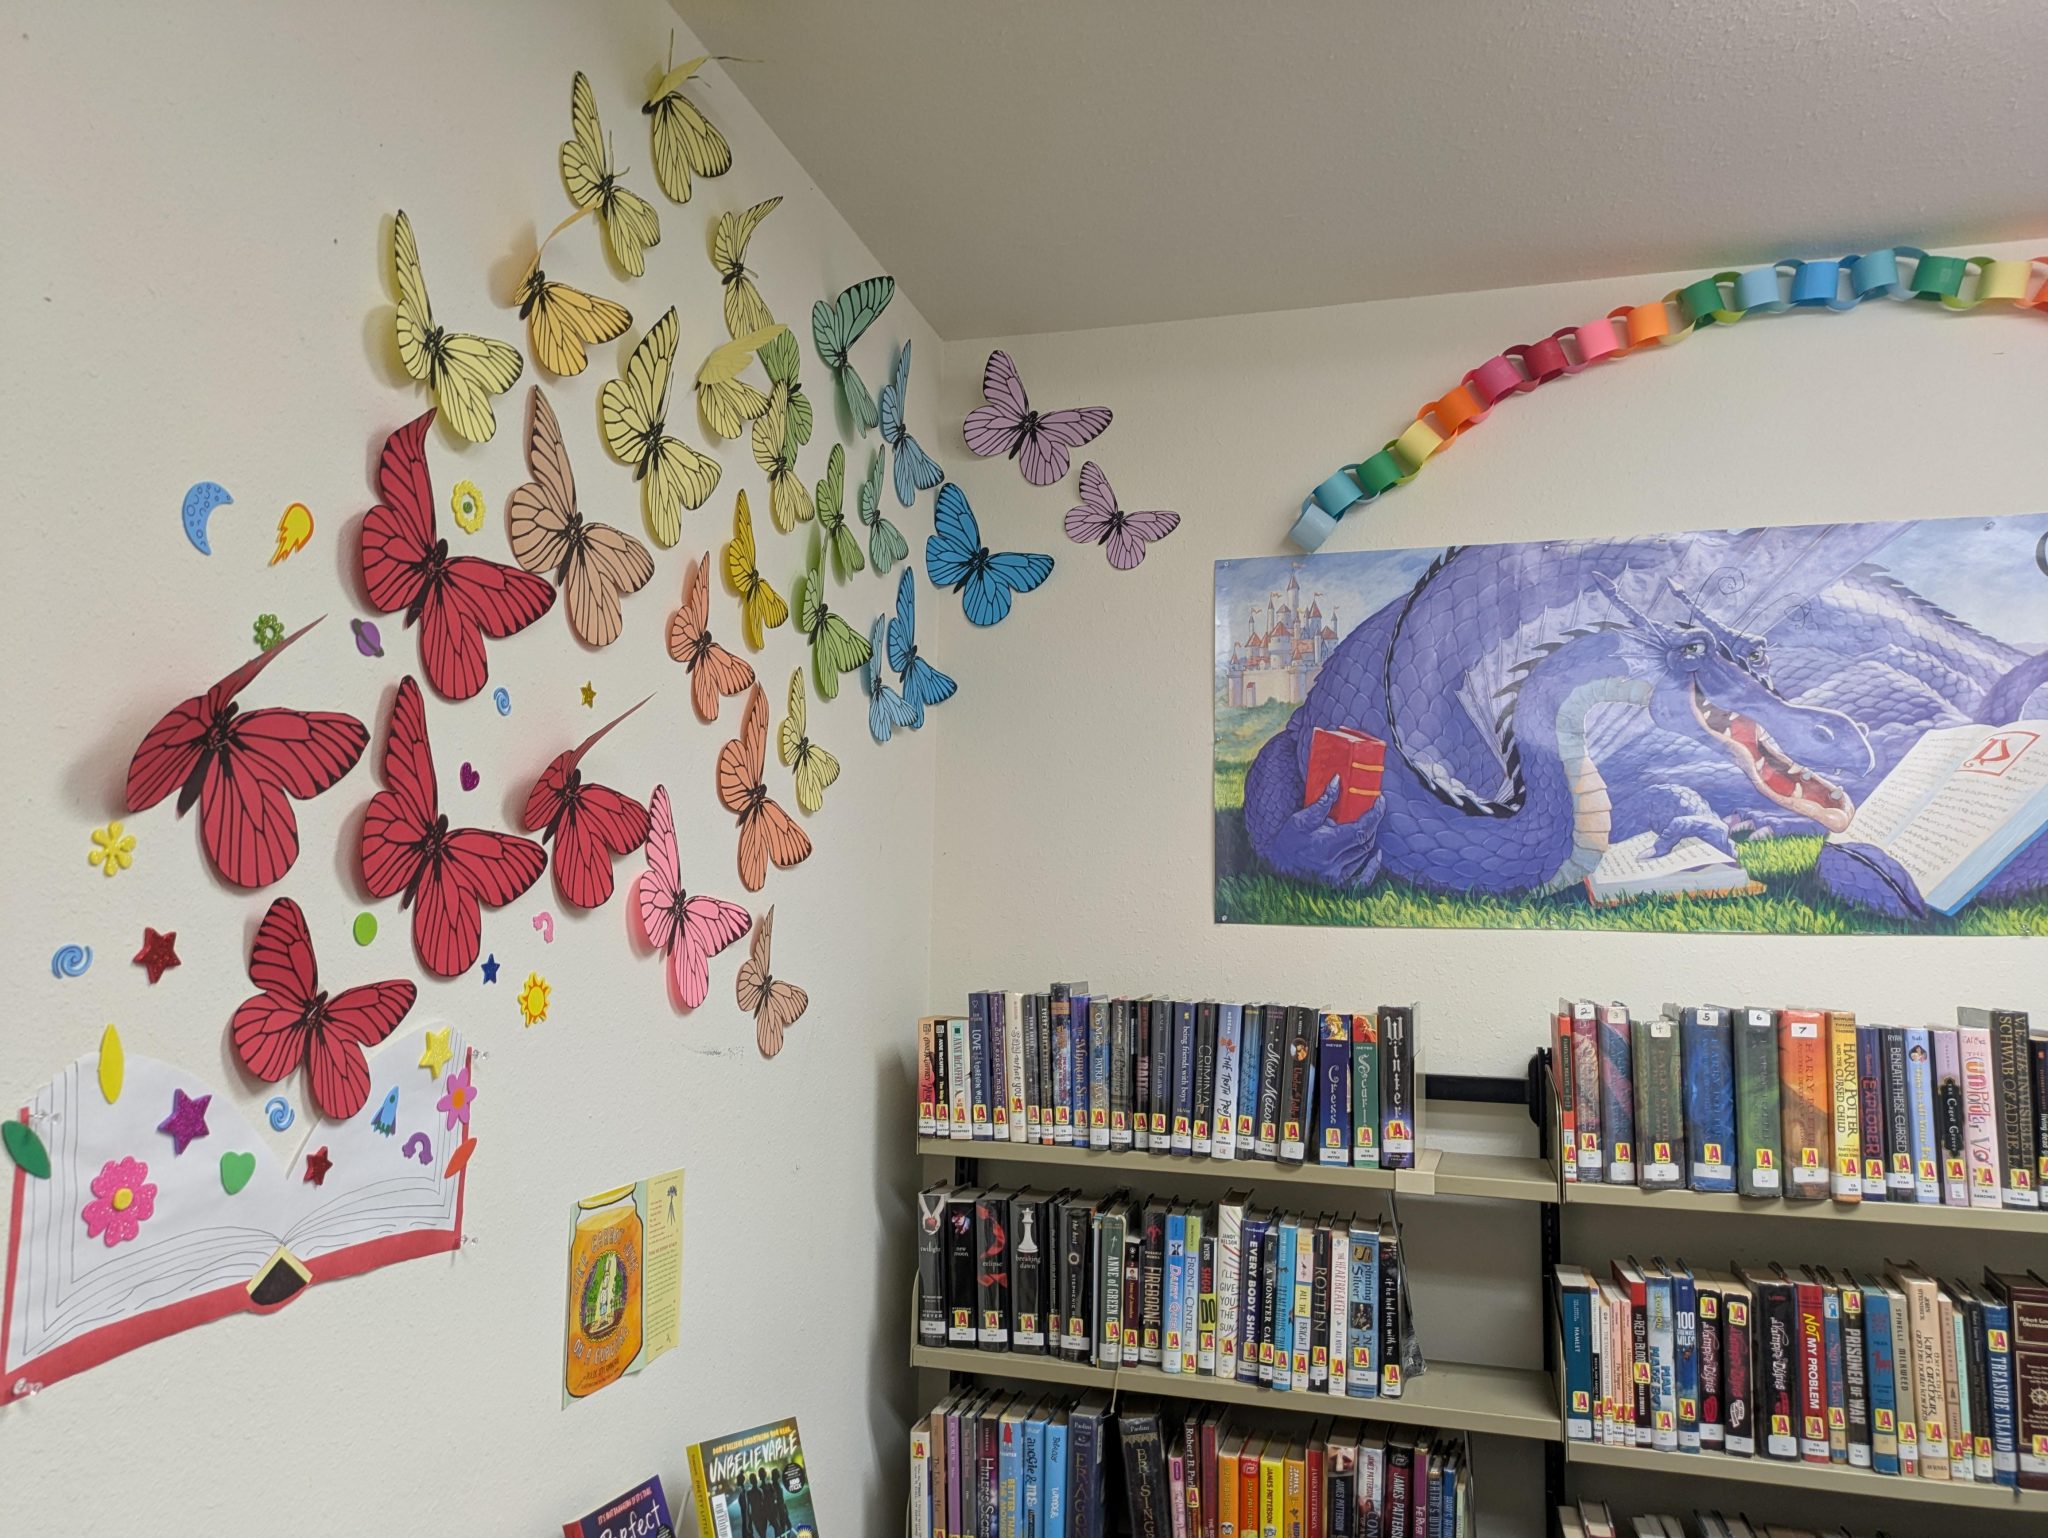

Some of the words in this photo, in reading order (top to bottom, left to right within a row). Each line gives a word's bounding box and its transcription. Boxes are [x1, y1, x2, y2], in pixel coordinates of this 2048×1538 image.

[1703, 1013, 1710, 1021] 5
[1799, 1026, 1807, 1034] 7
[2014, 1016, 2025, 1028] V.
[954, 1038, 962, 1053] ANNE
[972, 1029, 982, 1051] LOVE
[1180, 1026, 1189, 1045] being
[1999, 1015, 2013, 1075] SCHWAB
[2015, 1029, 2025, 1040] E.
[954, 1055, 963, 1087] McCAFFREY
[1181, 1046, 1190, 1069] friends
[1221, 1056, 1232, 1071] THE
[1266, 1043, 1280, 1078] Miss
[1384, 1016, 1403, 1119] Winter
[1805, 1042, 1814, 1094] HARRY
[1843, 1043, 1856, 1086] HARRY
[1890, 1047, 1902, 1085] BENEATH
[2016, 1044, 2029, 1073] THE
[973, 1061, 982, 1089] FOREIGN
[1221, 1073, 1231, 1095] TRUTH
[1835, 1068, 1844, 1102] CURSED
[2002, 1078, 2015, 1100] OF
[1180, 1087, 1189, 1102] boys
[1328, 1065, 1340, 1125] Cress
[1893, 1087, 1903, 1113] THESE
[1837, 1105, 1845, 1133] CHILD
[1846, 1089, 1858, 1138] POTTER
[1863, 1079, 1880, 1154] EXPLORER
[1946, 1098, 1957, 1122] Caged
[2018, 1075, 2034, 1151] INVISIBLE
[1895, 1115, 1906, 1152] CURSED
[2003, 1102, 2020, 1149] ADDIE
[1107, 1256, 1119, 1277] ANNE
[1247, 1241, 1258, 1275] EVERY
[1108, 1279, 1118, 1287] of
[1186, 1256, 1195, 1289] FRONT
[1351, 1265, 1364, 1299] Silver
[1385, 1278, 1393, 1286] if
[1143, 1267, 1161, 1326] FIREBORNE
[1219, 1283, 1235, 1291] GIVE
[1247, 1280, 1257, 1311] BODY
[1264, 1278, 1272, 1322] MONSTER
[1299, 1290, 1307, 1302] ALL
[1313, 1266, 1327, 1332] ROTTEN
[1334, 1260, 1345, 1316] HEARTBREAKERS
[1386, 1287, 1393, 1297] he
[1107, 1289, 1119, 1314] GREEN
[1185, 1297, 1194, 1333] CENTER
[1219, 1296, 1235, 1307] YOU
[1220, 1310, 1235, 1320] THE
[1299, 1303, 1307, 1314] THE
[1386, 1298, 1394, 1310] had
[1654, 1293, 1662, 1329] SKOVRON
[1219, 1323, 1234, 1332] SUN
[1246, 1314, 1256, 1342] SHIN
[1386, 1311, 1394, 1327] been
[1634, 1319, 1643, 1335] RED
[1676, 1312, 1695, 1330] 100
[1802, 1313, 1820, 1342] NOT
[1895, 1308, 1903, 1341] SPINELLI
[1263, 1326, 1271, 1344] CAL
[1298, 1322, 1309, 1346] BRIGHT
[1386, 1329, 1396, 1345] with
[1806, 1337, 1816, 1354] MY
[1650, 1346, 1661, 1384] MADE
[1844, 1327, 1861, 1384] PRISONER
[1661, 1365, 1672, 1396] MAN
[1807, 1357, 1819, 1409] PROBLEM
[1898, 1348, 1908, 1392] MILKWEED
[1990, 1357, 2009, 1410] TREASURE
[1651, 1385, 1662, 1412] BOY
[1851, 1386, 1862, 1398] OF
[1849, 1398, 1865, 1425] WAR
[1186, 1428, 1194, 1457] Robert
[1994, 1413, 2013, 1452] ISLAND
[708, 1430, 798, 1483] UNBELIEVABLE
[1187, 1460, 1194, 1469] B.
[1367, 1455, 1375, 1471] JAMES
[980, 1458, 994, 1502] HITLER'S
[1336, 1479, 1344, 1498] JAMES
[1393, 1472, 1404, 1499] JAMES
[1007, 1478, 1015, 1511] BETTER
[980, 1504, 994, 1538] SECRE
[1336, 1498, 1344, 1531] PATTERSON
[1415, 1505, 1425, 1517] THE
[1415, 1517, 1425, 1535] RIVER
